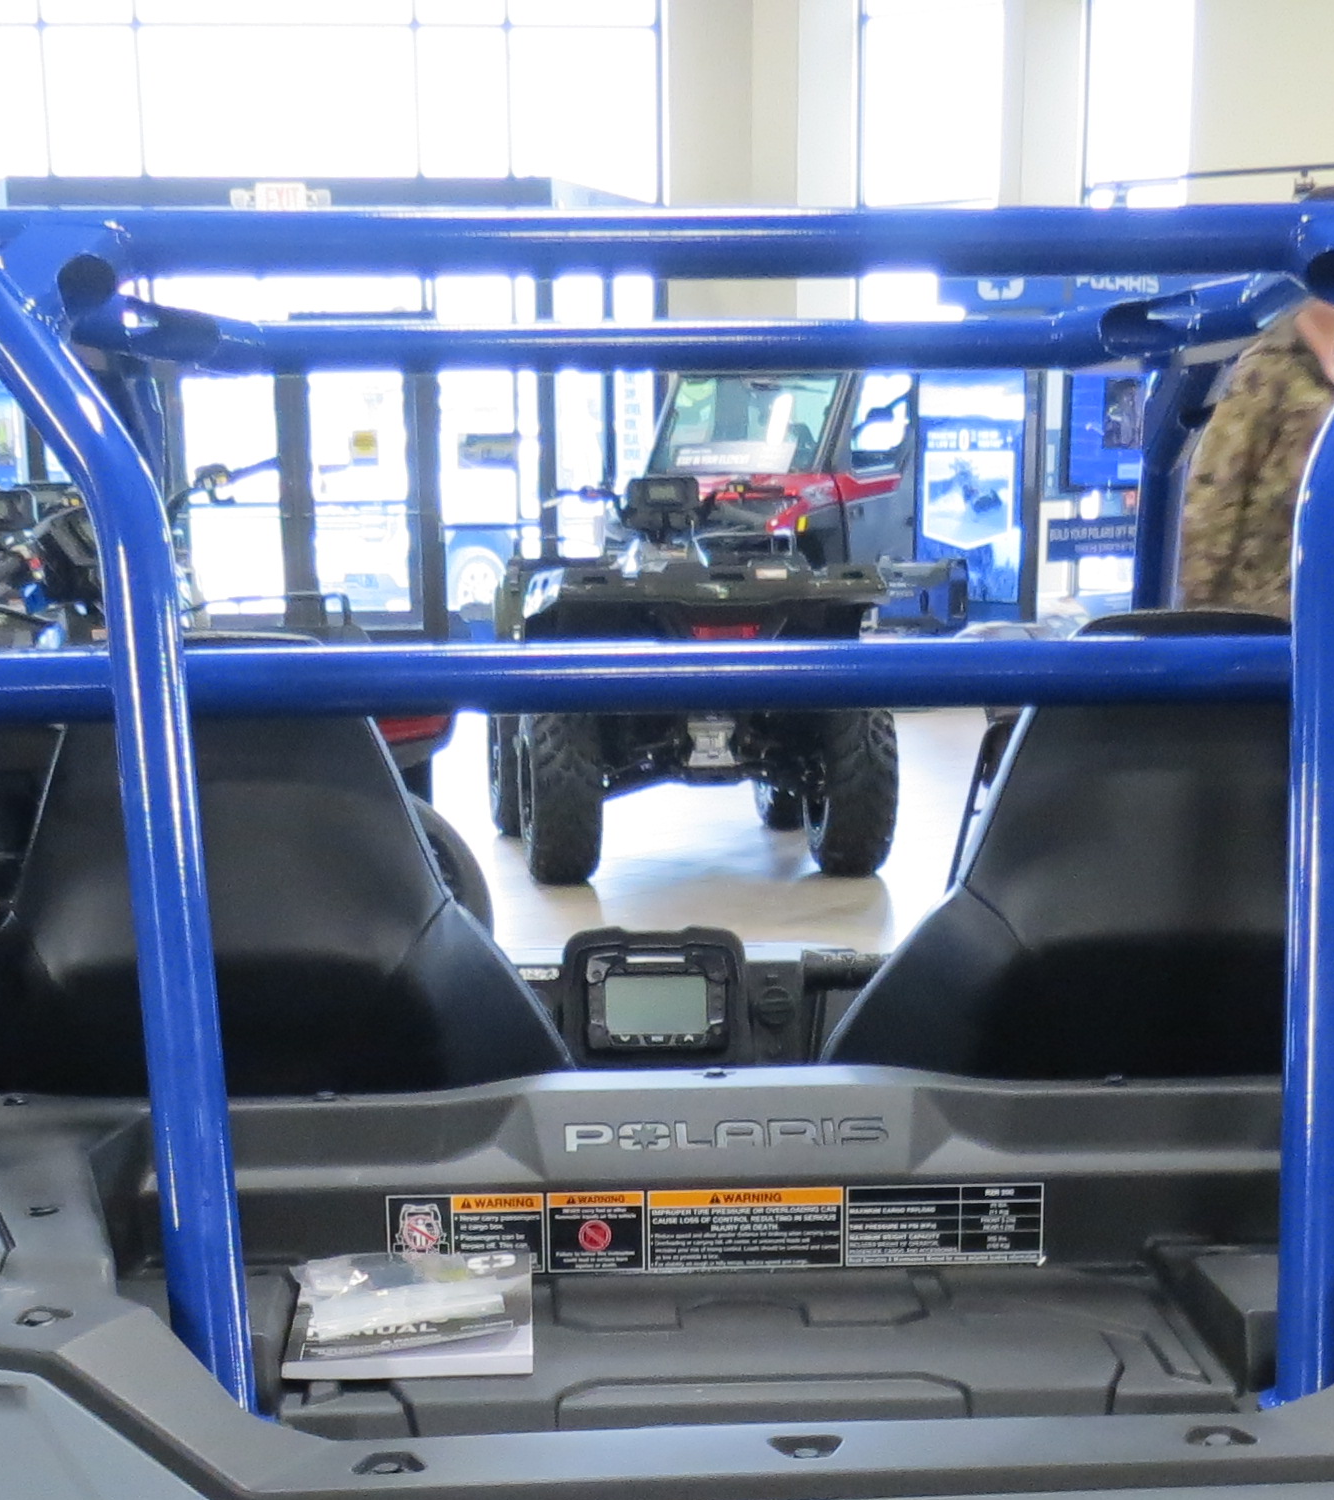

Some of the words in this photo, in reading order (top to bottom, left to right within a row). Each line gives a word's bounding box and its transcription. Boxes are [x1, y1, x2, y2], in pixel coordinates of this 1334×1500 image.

[265, 186, 300, 206] EXIT
[563, 1117, 889, 1152] POLARIS
[577, 1195, 626, 1204] WARNING
[723, 1193, 782, 1203] WARNING
[474, 1198, 534, 1209] WARNING
[481, 1215, 498, 1223] carry
[712, 1215, 747, 1223] CONTROL
[711, 1224, 739, 1232] INJURY
[739, 1223, 751, 1231] OR
